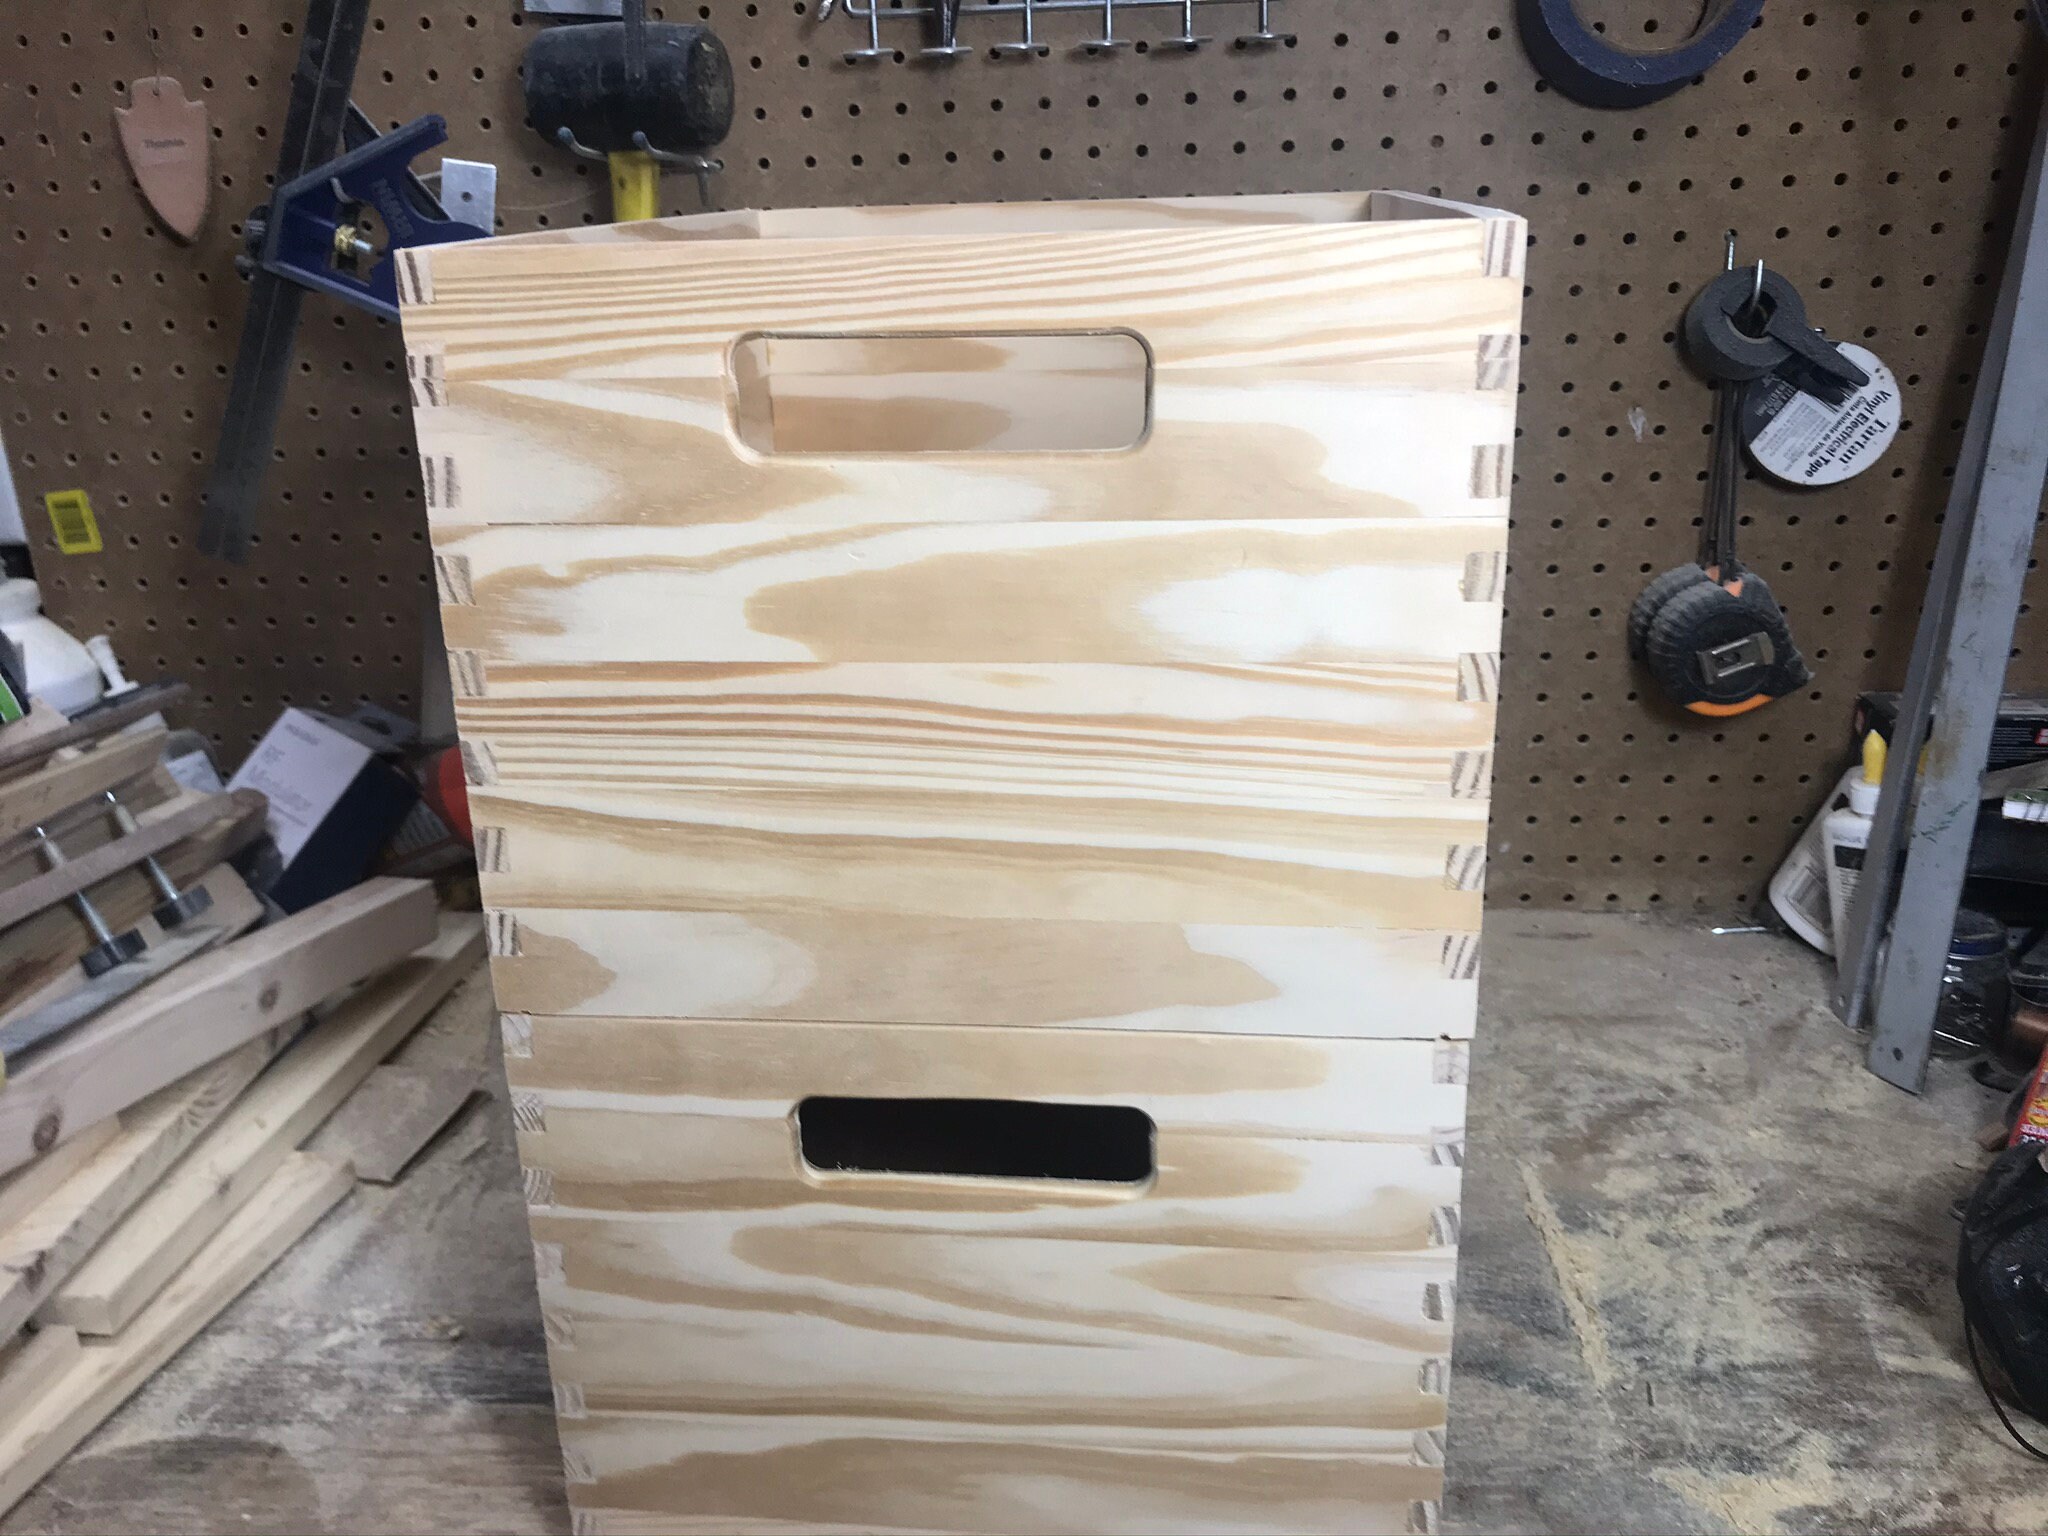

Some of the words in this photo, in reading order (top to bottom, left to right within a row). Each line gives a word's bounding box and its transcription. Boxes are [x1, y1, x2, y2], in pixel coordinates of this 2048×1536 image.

[1850, 396, 1867, 411] Cinta
[1865, 390, 1892, 414] Vinyl
[1825, 412, 1870, 458] Electrical
[1839, 419, 1890, 465] Tartan
[1805, 455, 1831, 478] Tape
